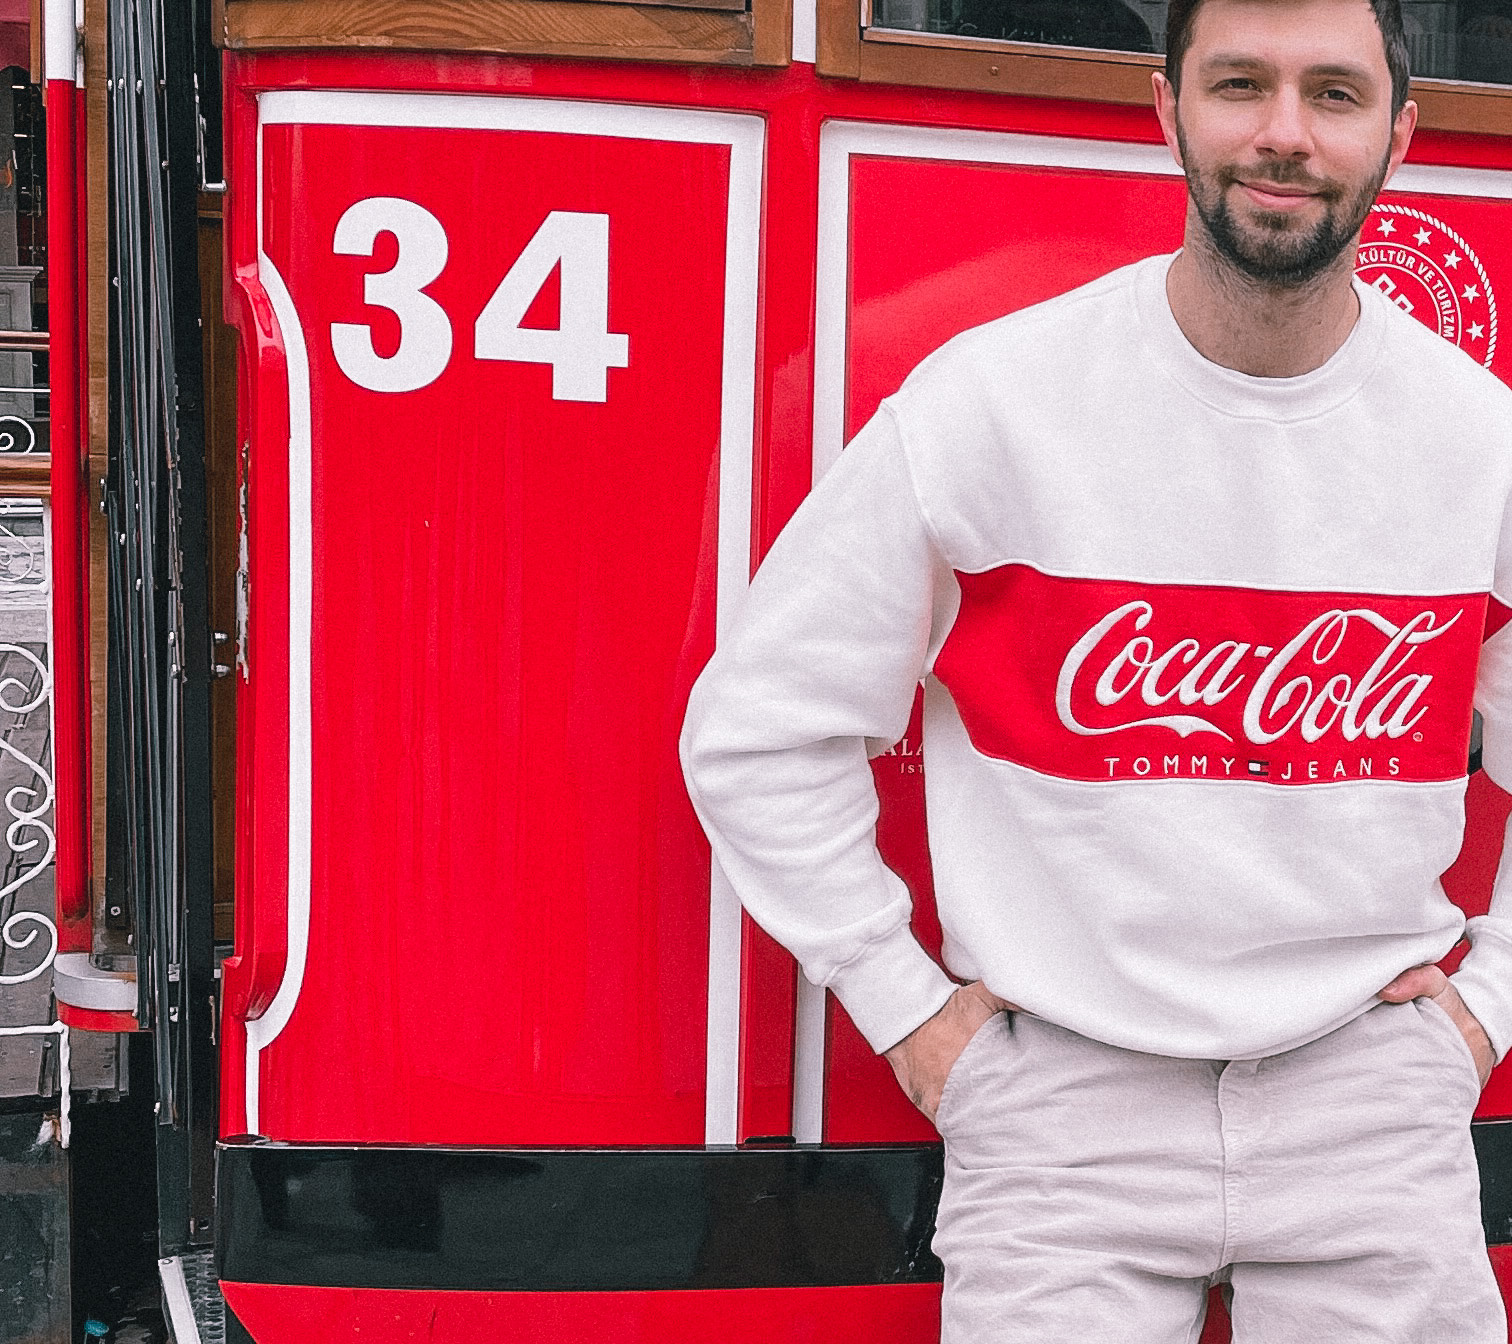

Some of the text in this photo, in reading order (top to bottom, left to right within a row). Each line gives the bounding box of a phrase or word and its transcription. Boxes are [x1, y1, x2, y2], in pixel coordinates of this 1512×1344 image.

[330, 195, 629, 403] 34
[1358, 247, 1456, 339] KÜLTÜR VE TURİZM
[1055, 599, 1464, 746] Coca-Cola
[1104, 756, 1401, 781] TOMMY JEANS
